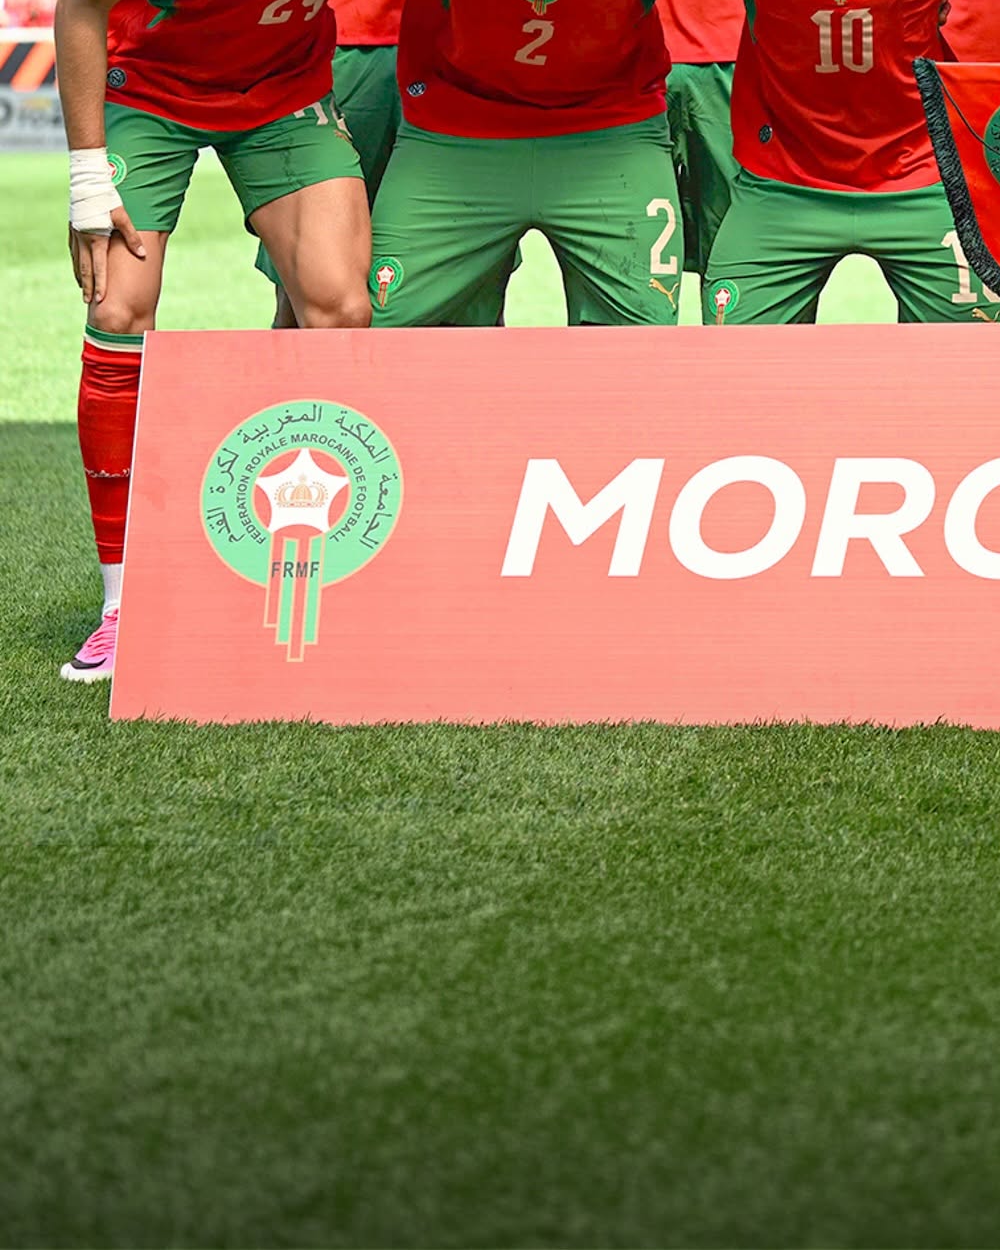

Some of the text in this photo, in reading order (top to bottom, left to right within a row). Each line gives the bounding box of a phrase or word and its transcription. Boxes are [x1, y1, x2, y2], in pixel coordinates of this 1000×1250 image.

[514, 18, 555, 66] 2
[810, 7, 874, 74] 10
[646, 198, 678, 275] 2
[207, 403, 398, 549] الجامعة الملكية المغربية لكرة القدم
[236, 433, 367, 545] FEDERATION ROYALE MAROCAINE DE FOOTBALL
[271, 561, 320, 578] FRMF
